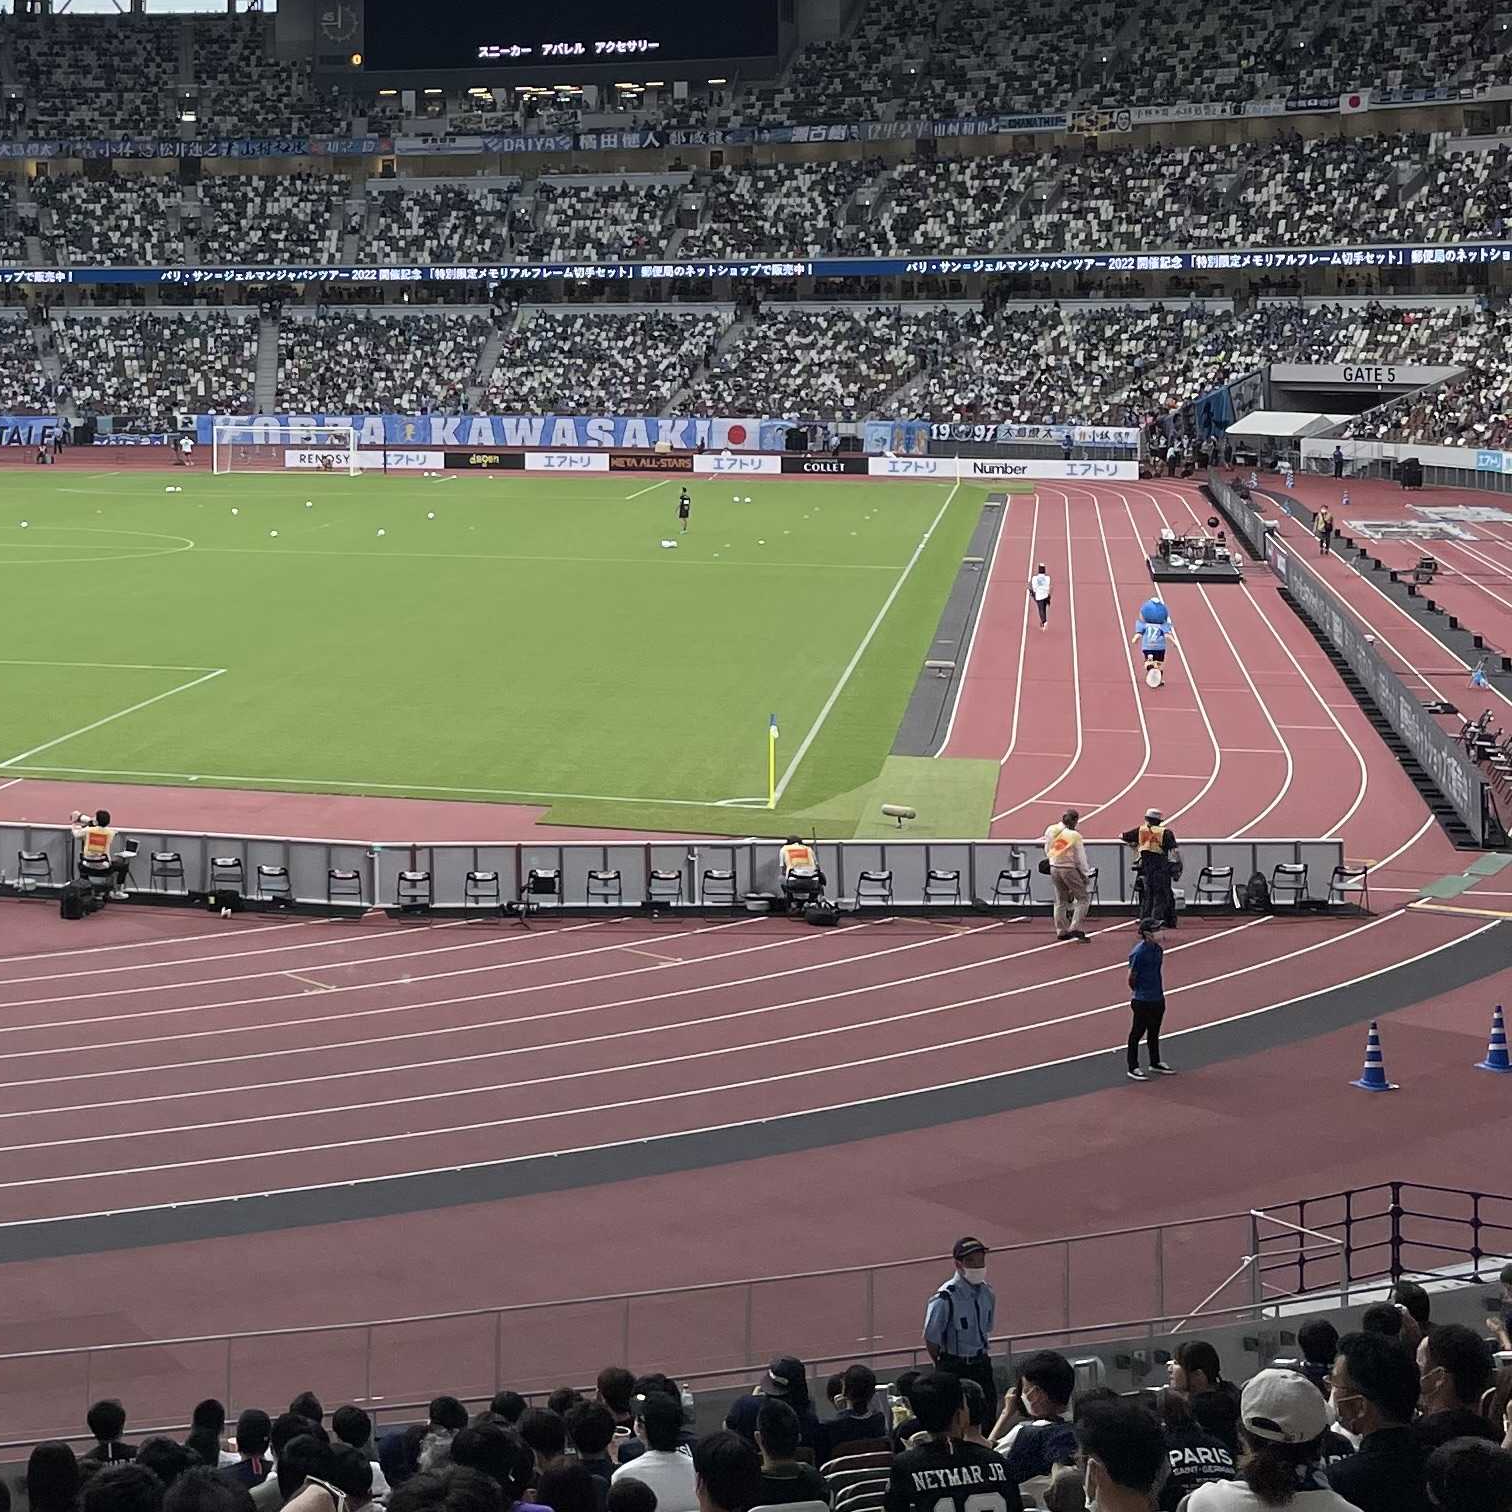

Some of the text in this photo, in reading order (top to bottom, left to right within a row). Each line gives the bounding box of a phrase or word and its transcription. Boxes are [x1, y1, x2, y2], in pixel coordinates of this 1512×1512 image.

[478, 40, 660, 57] スニーカー アパレル アクセサリー
[1343, 366, 1396, 383] GATE 5
[430, 416, 710, 449] KAWASAKI
[931, 424, 997, 441] 19 97
[299, 453, 350, 466] RENOSY
[544, 455, 591, 468] エアトリ
[713, 457, 762, 471] エアトリ
[888, 460, 937, 473] エアトリ
[803, 462, 845, 472] COLLET
[973, 462, 1028, 476] Number
[1066, 463, 1118, 476] エアトリ
[1169, 1447, 1233, 1467] PARIS
[912, 1462, 1007, 1492] NEYMAR JR
